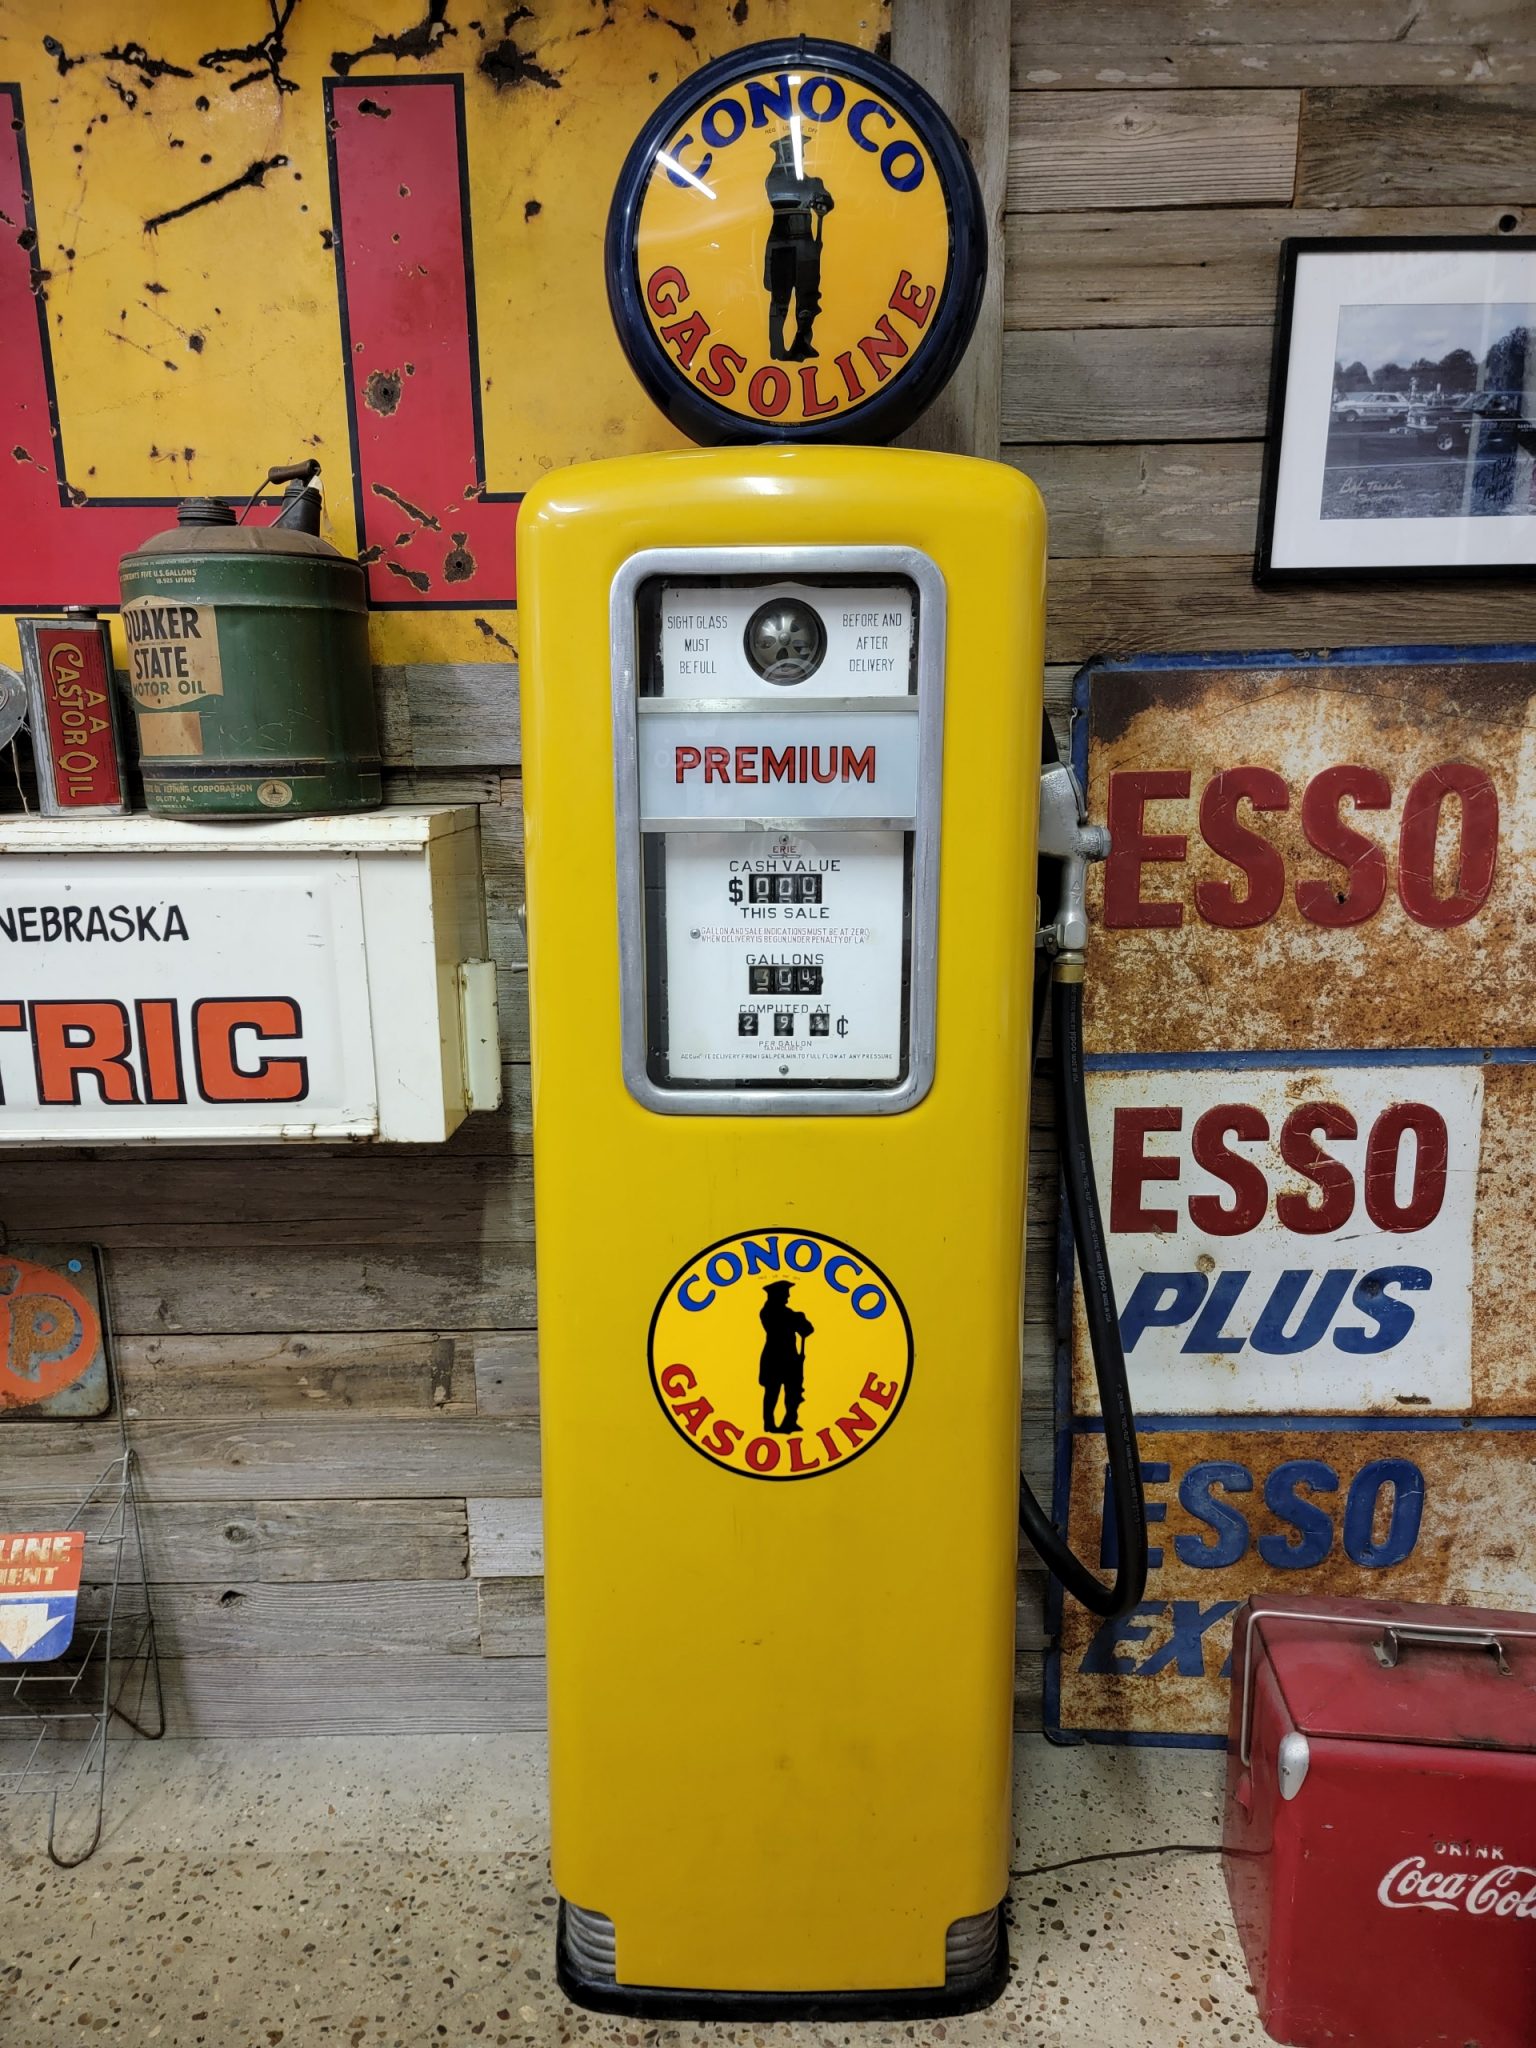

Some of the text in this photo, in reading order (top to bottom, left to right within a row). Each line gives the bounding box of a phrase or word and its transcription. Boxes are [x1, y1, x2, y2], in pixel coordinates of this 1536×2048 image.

[665, 74, 925, 193] CONOCO
[647, 265, 936, 418] GASOLINE
[141, 570, 152, 578] FIVE
[123, 607, 202, 644] QUAKER
[667, 615, 728, 630] SIGHT GLASS
[842, 612, 902, 628] BEFORE AND
[684, 638, 710, 652] MUST
[856, 636, 888, 650] AFTER
[134, 646, 189, 680] STATE
[679, 660, 717, 674] BE FULL
[849, 658, 895, 672] DELIVERY
[133, 680, 206, 697] MOTOR OIL
[48, 642, 99, 798] CASTOR OIL
[675, 746, 876, 784] PREMIUM
[193, 783, 253, 793] CORPORATION
[772, 845, 797, 854] ERIE
[1104, 763, 1499, 930] ESSO
[729, 859, 841, 872] CASH VALUE
[740, 907, 830, 919] THIS SALE
[0, 905, 189, 942] NEBRASKA
[701, 927, 728, 935] GALLON
[730, 927, 743, 935] AND
[744, 927, 762, 935] SALE
[763, 927, 806, 935] INDICATIONS
[807, 927, 826, 935] MUST
[829, 927, 838, 935] BE
[840, 927, 849, 935] AT
[701, 936, 720, 944] WHEN
[722, 936, 755, 944] DELIVERY
[756, 936, 762, 944] IS
[764, 936, 786, 944] BEGUN
[788, 936, 810, 944] UNDER
[812, 936, 843, 944] PENALTY
[746, 953, 824, 965] GALLONS
[739, 1004, 831, 1013] COMPUTED AT
[1110, 1102, 1449, 1237] ESSO
[677, 1236, 887, 1319] CONOCO
[1118, 1265, 1433, 1355] PLUS
[661, 1363, 898, 1472] GASOLINE
[1101, 1458, 1425, 1569] ESSO
[1079, 1601, 1232, 1678] EX
[1433, 1840, 1505, 1861] DRINK
